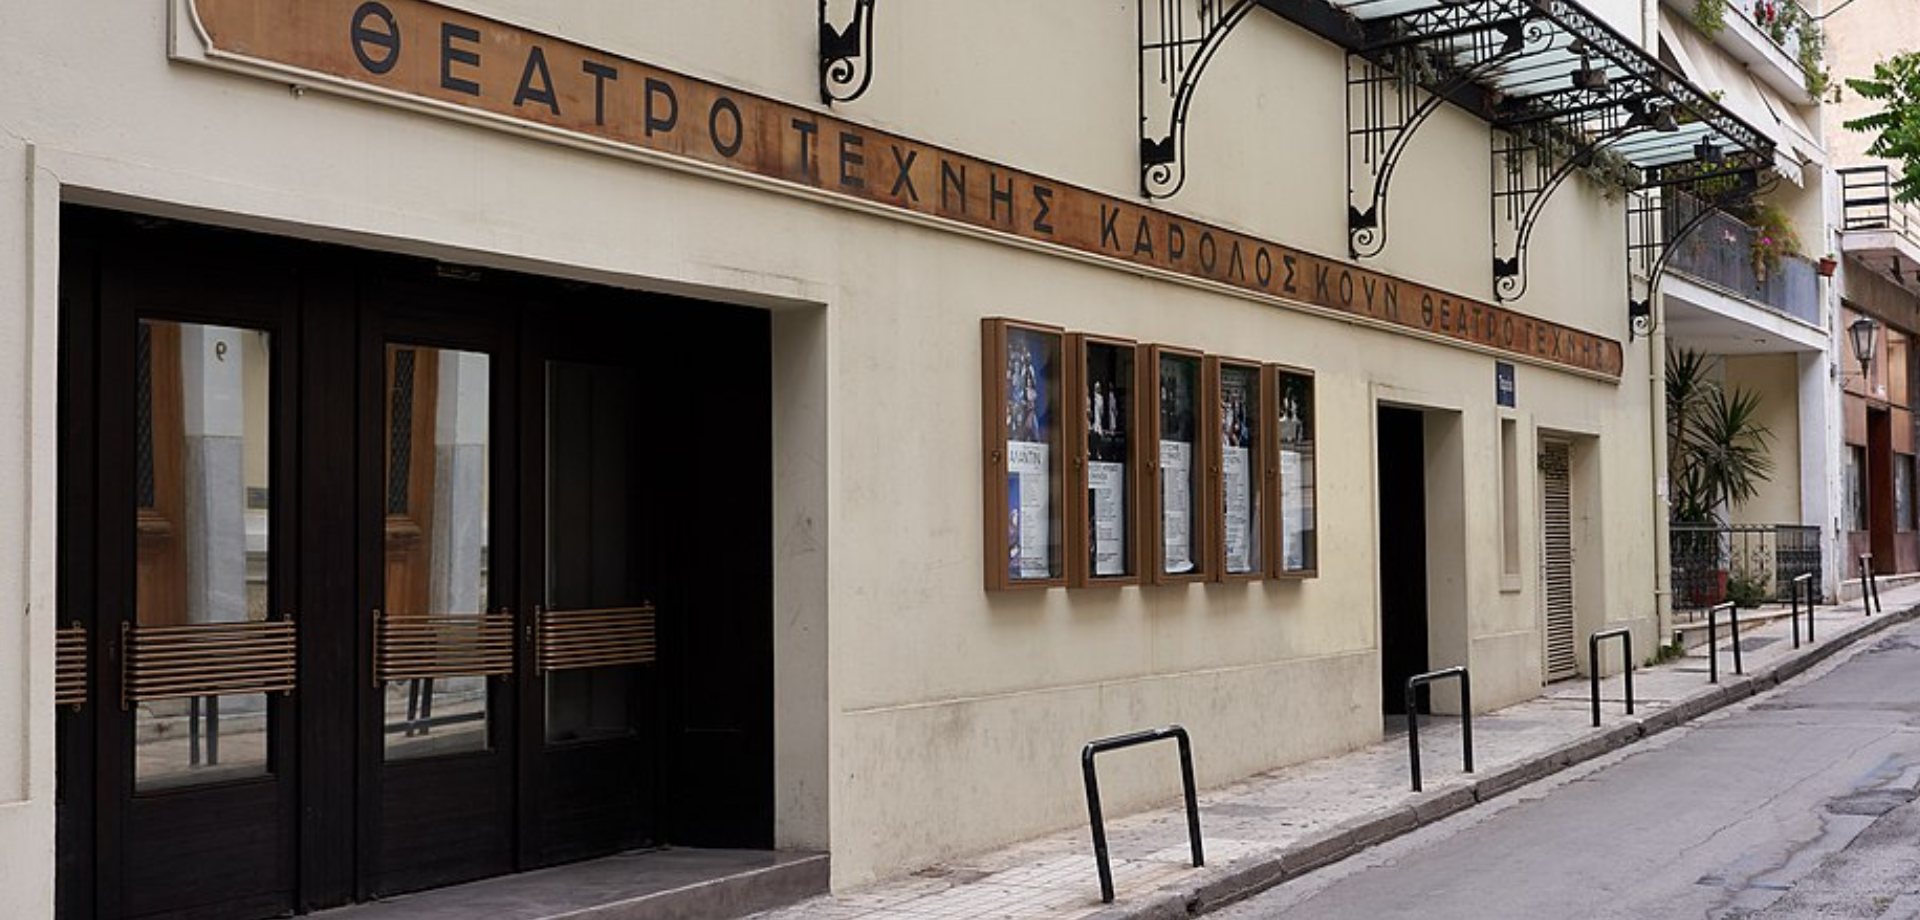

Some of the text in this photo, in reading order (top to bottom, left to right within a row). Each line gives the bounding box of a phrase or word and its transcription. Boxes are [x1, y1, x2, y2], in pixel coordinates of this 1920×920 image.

[351, 1, 1604, 368] ΘΕΑΤΡΟ ΤΕΧΝΗΣ ΚΑΡΟΛΟΣ ΚΟΥΝ ΘΕΑΤΡΟ ΤΕΧΝΗΣ
